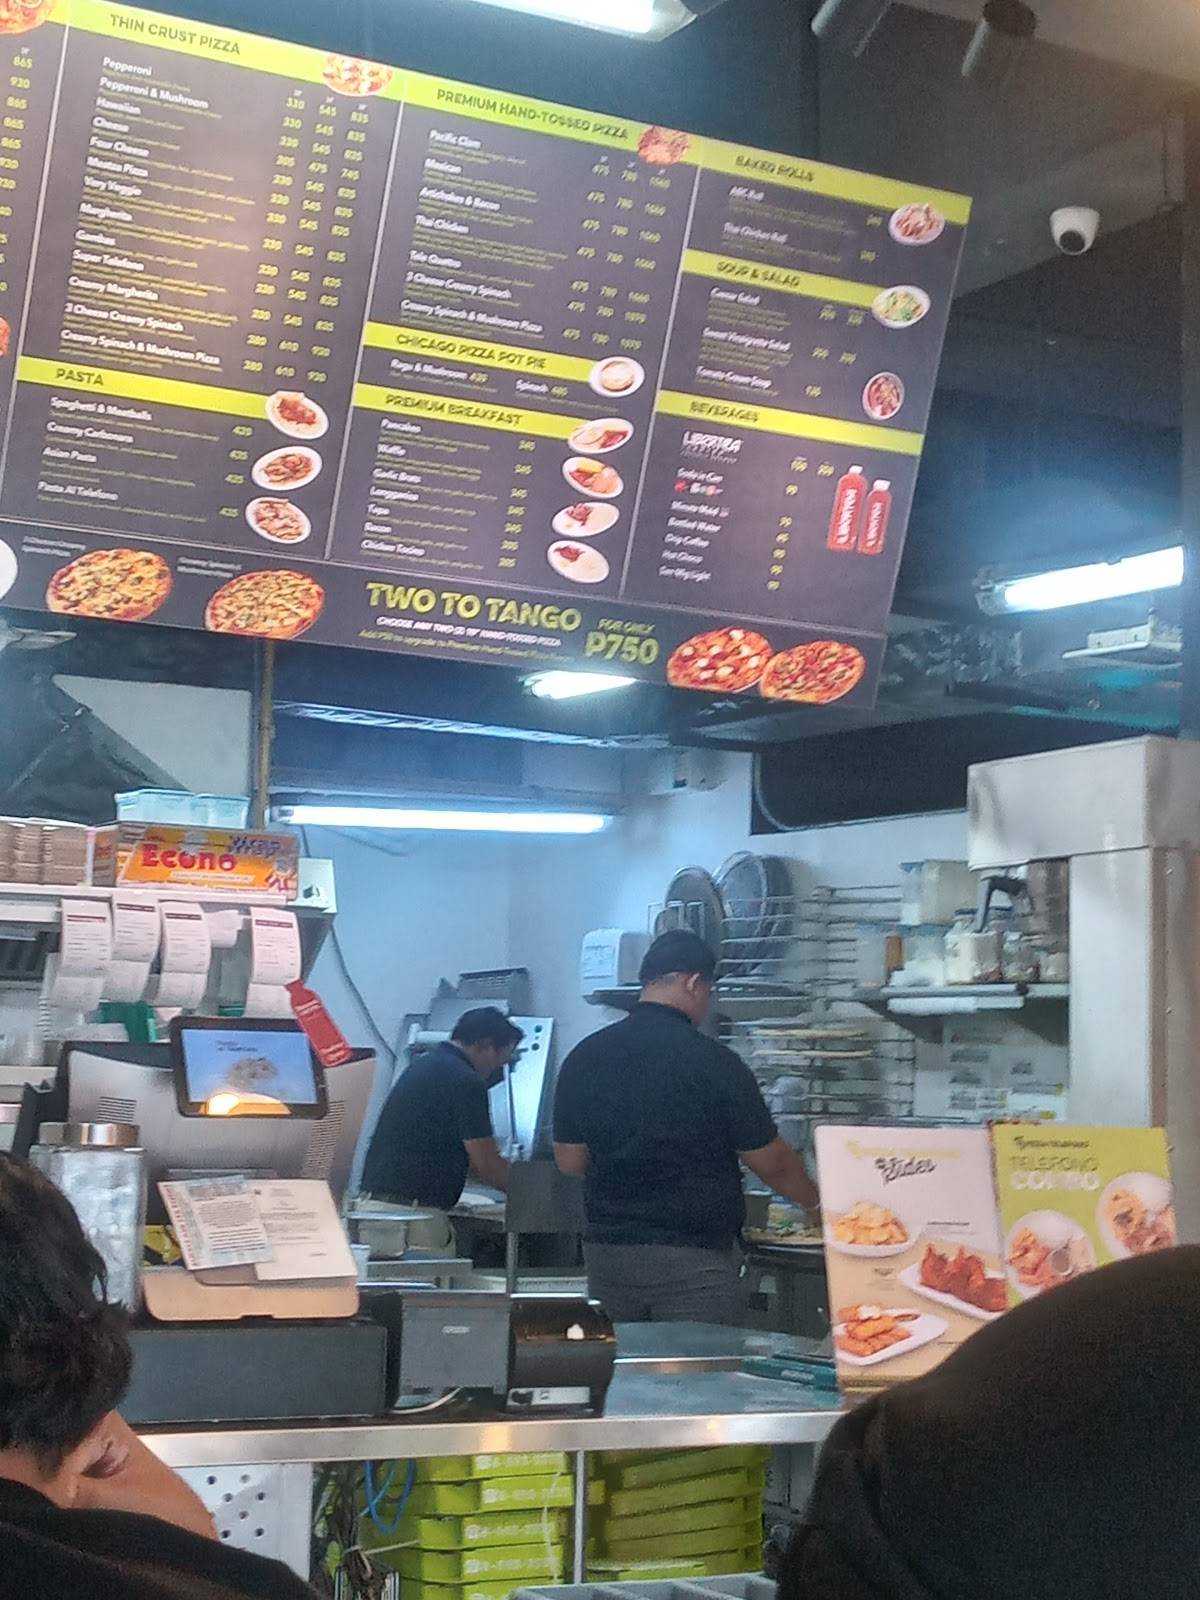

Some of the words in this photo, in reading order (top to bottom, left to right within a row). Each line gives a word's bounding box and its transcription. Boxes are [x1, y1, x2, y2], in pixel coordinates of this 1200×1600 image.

[109, 14, 144, 32] THIN
[147, 23, 196, 44] CRUST
[199, 35, 241, 54] PIZZA
[14, 56, 33, 69] 865
[103, 57, 152, 77] Pepperoni
[10, 76, 31, 89] 930
[99, 76, 148, 96] Pepperoni
[159, 90, 208, 108] Mushroom
[7, 96, 28, 110] 865
[96, 96, 141, 114] Hawaiian
[286, 97, 304, 109] 330
[319, 104, 336, 116] 545
[351, 111, 368, 123] 835
[436, 88, 497, 112] PREMIUM
[499, 102, 590, 132] HAND-TOSSED
[592, 122, 628, 139] PIZZA
[92, 116, 129, 132] Cheese
[315, 123, 333, 136] 545
[113, 141, 149, 157] Cheese
[68, 276, 106, 292] Creamy
[73, 304, 109, 318] Cheese
[107, 310, 145, 326] Creamy
[143, 316, 183, 333] Spinach
[60, 329, 97, 345] Creamy
[96, 335, 136, 351] Spinach
[145, 343, 195, 360] Mushroom
[195, 351, 220, 364] Pizza
[396, 333, 456, 353] CHICAGO
[458, 344, 495, 360] PIZZA
[498, 351, 524, 365] POT
[526, 355, 546, 368] PIE
[56, 367, 104, 385] PASTA
[385, 393, 445, 412] PREMIUM
[447, 403, 522, 425] BREAKFAST
[690, 401, 759, 422] BEVERAGES
[46, 421, 84, 437] Creamy
[70, 450, 97, 462] Pasta
[363, 580, 438, 614] TWO
[438, 590, 482, 620] TO
[482, 596, 583, 633] TANGO
[583, 630, 660, 665] P750
[141, 843, 238, 872] Econo
